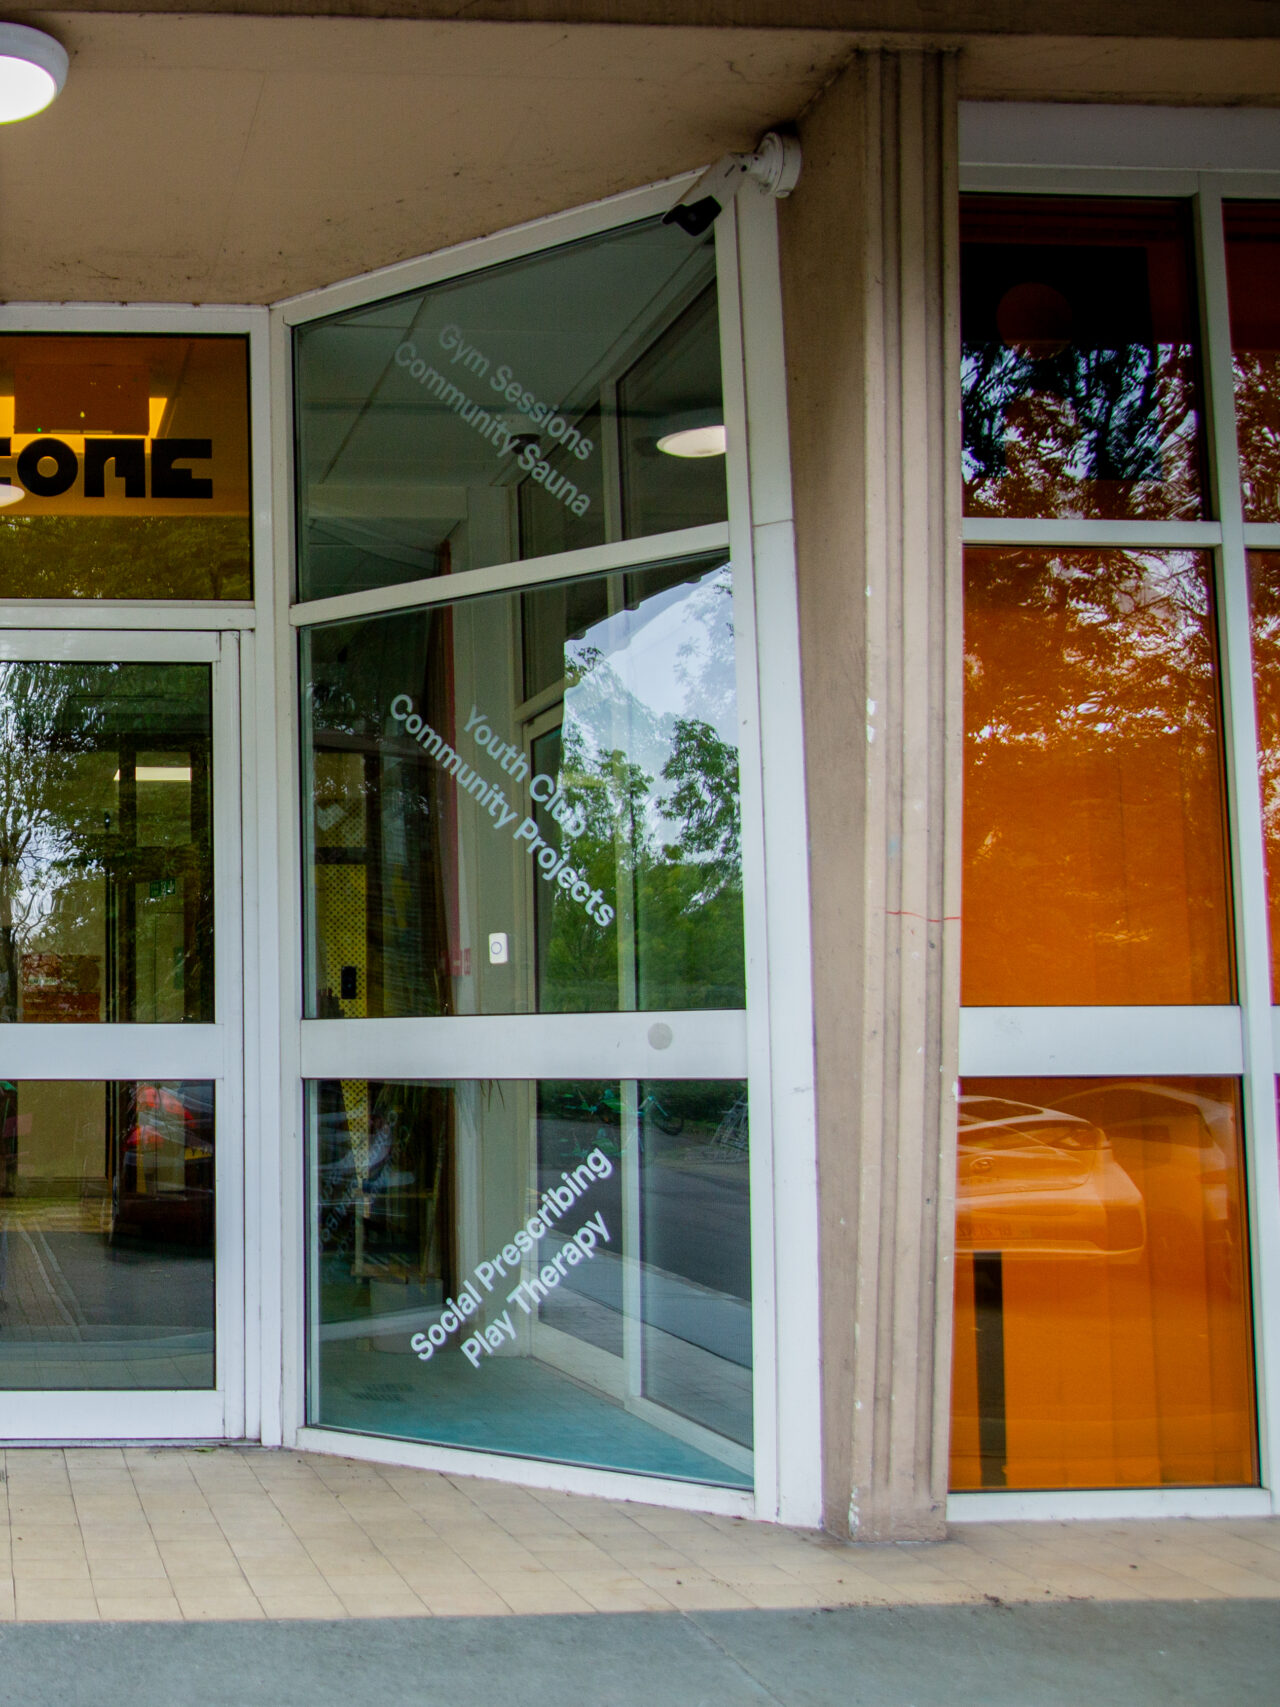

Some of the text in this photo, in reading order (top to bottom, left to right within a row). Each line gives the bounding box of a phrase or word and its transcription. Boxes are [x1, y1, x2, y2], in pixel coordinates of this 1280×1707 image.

[394, 341, 591, 517] Community Sauna
[439, 324, 594, 461] Gym Sessions
[391, 694, 615, 927] Community Projects
[464, 704, 586, 838] Youth Club
[410, 1147, 613, 1360] Social Prescribing
[460, 1211, 612, 1368] Play Therapy
